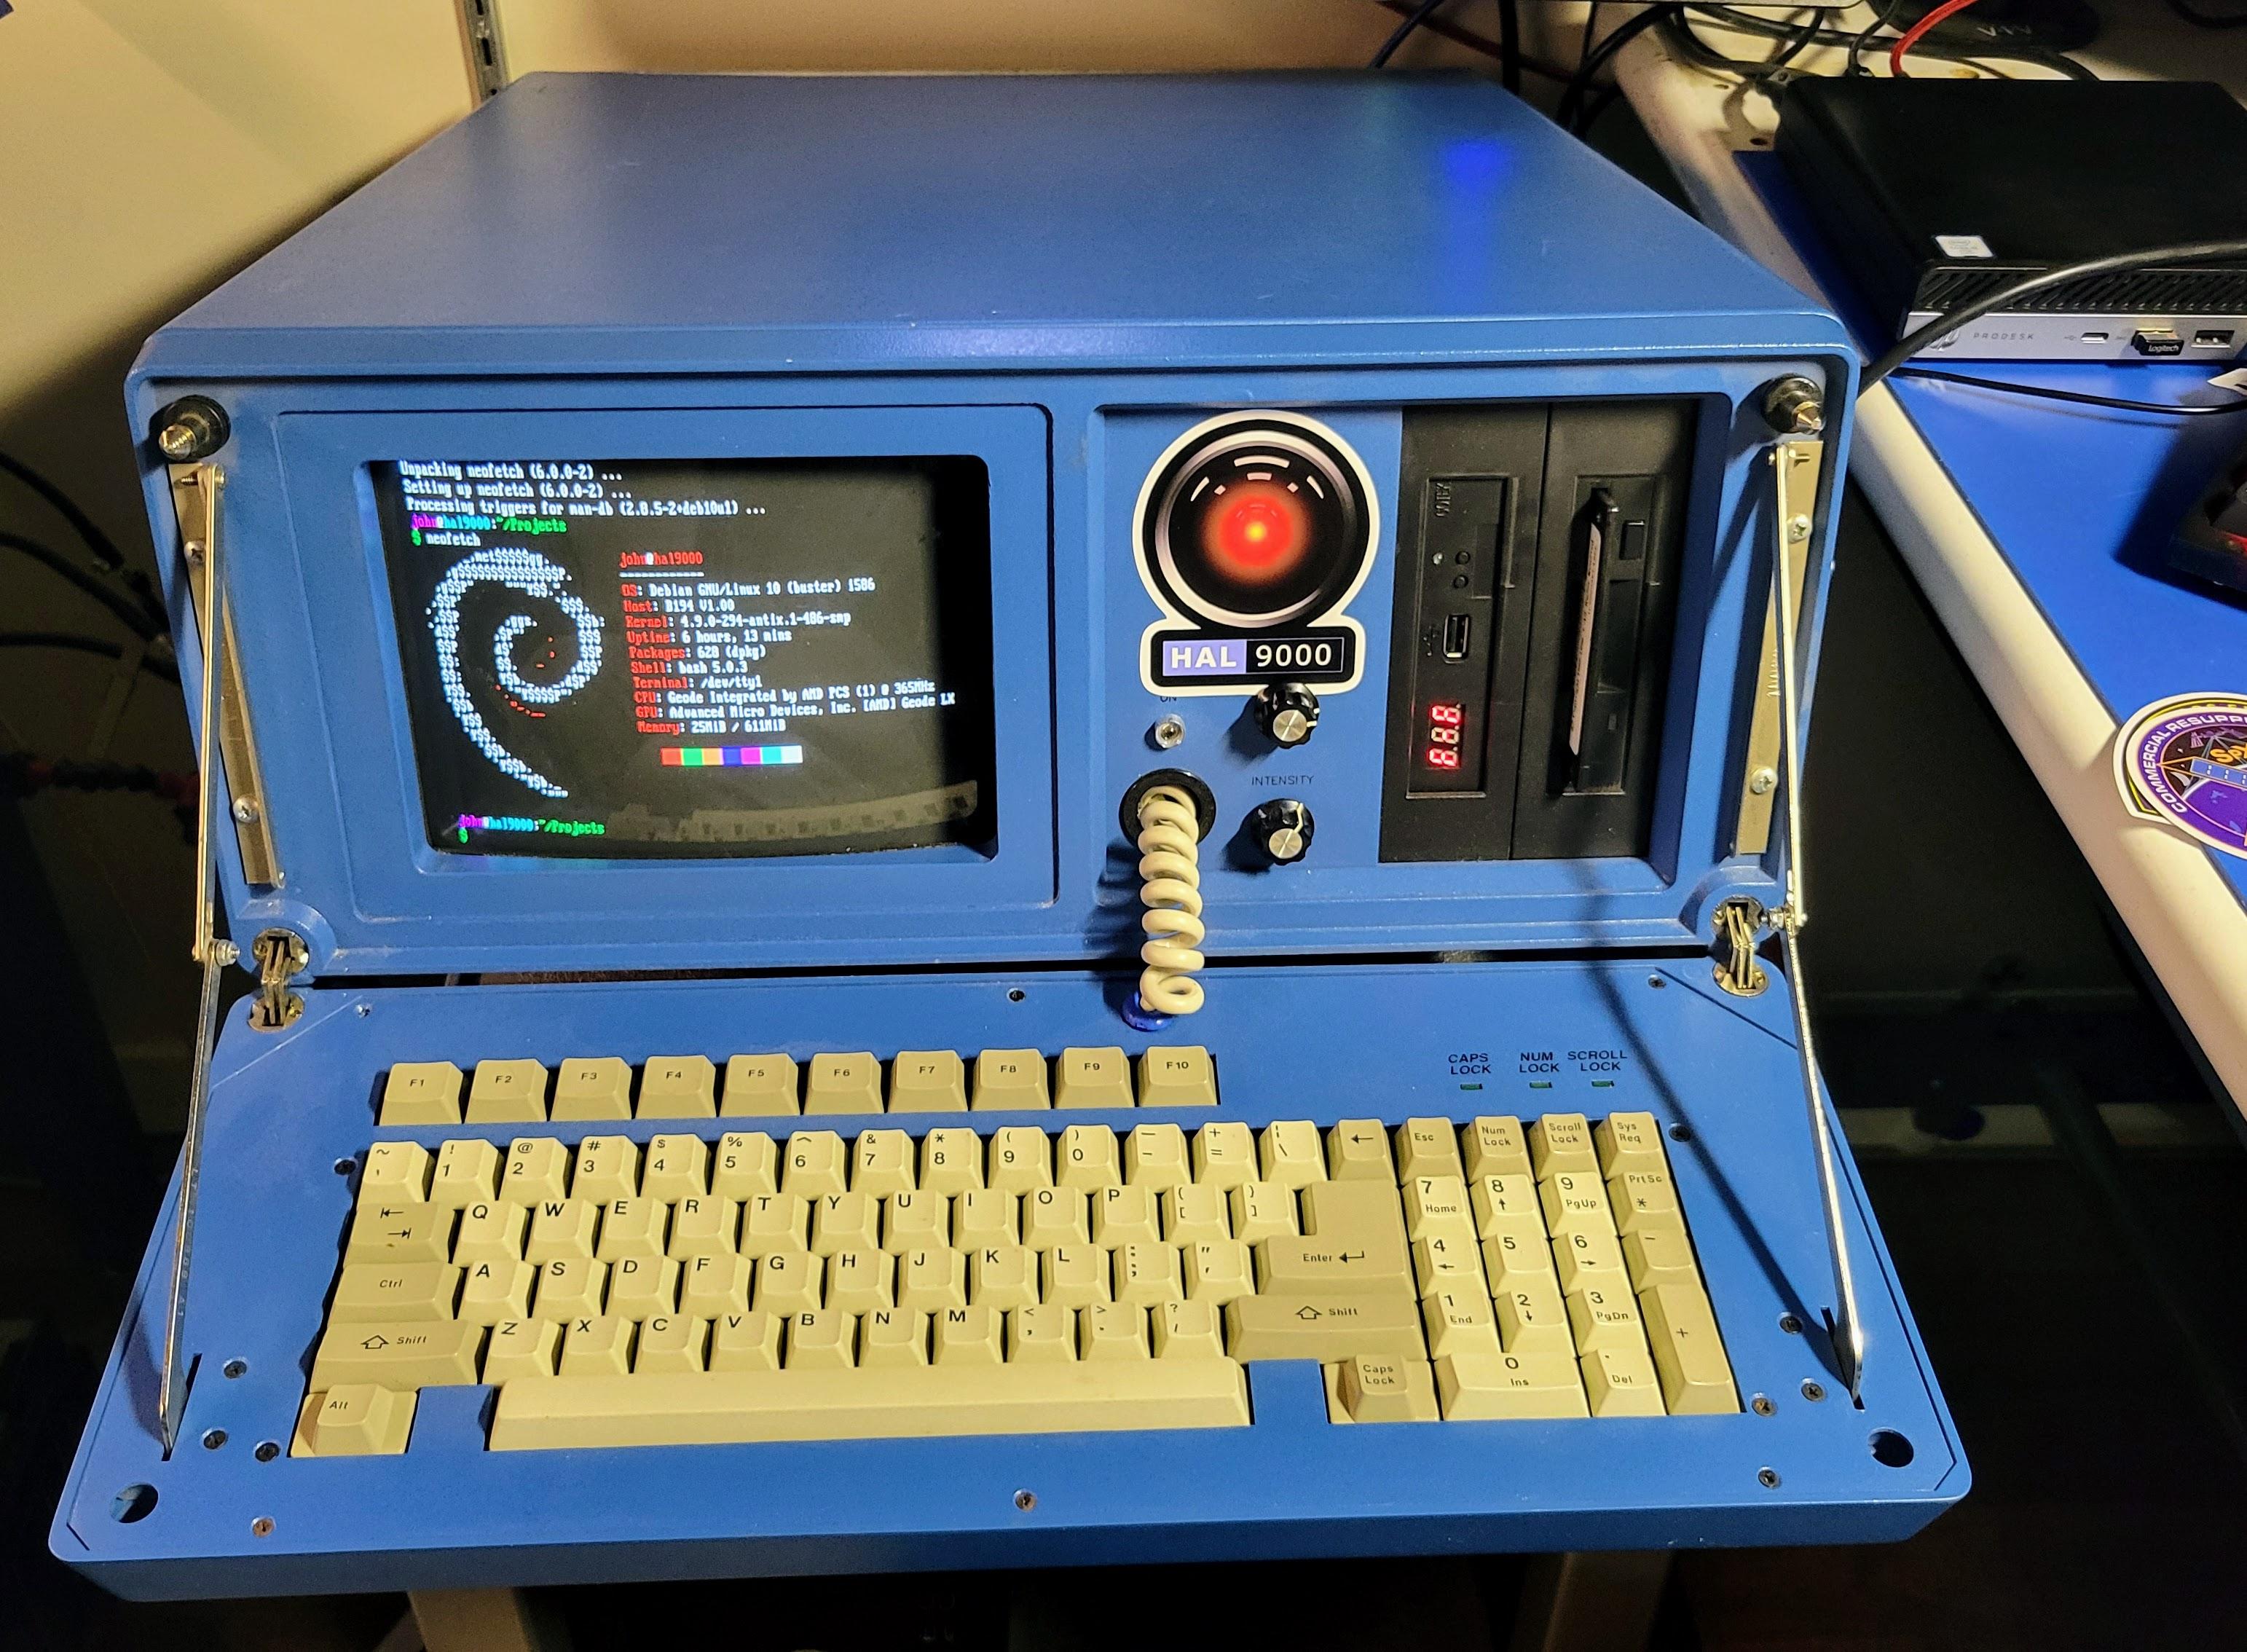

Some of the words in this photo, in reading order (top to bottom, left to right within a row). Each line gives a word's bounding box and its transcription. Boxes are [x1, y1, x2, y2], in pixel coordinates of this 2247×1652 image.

[1973, 332, 2035, 340] PRODESK
[398, 460, 463, 481] Unpacking
[466, 463, 524, 479] neofetch
[402, 478, 452, 498] Setting
[455, 484, 472, 499] up
[476, 481, 534, 497] neofetch
[405, 495, 475, 516] Processing
[479, 499, 537, 517] triggers
[540, 500, 564, 516] for
[425, 532, 481, 546] neofetch
[648, 583, 693, 597] Debian
[697, 581, 760, 597] GNU/Linux
[766, 581, 781, 595] 10
[787, 578, 842, 594] (buster)
[623, 599, 659, 613] Host:
[625, 615, 674, 629] Kernel:
[626, 630, 676, 645] Uptime:
[681, 630, 690, 644] 6
[695, 629, 737, 644] hours,
[744, 629, 759, 643] 13
[763, 629, 792, 642] mins
[629, 645, 691, 661] Packages:
[725, 644, 766, 661] (dpkg)
[1170, 646, 1237, 669] HAL
[1255, 644, 1332, 668] 9000
[631, 661, 672, 674] Shell:
[677, 661, 708, 674] bash
[712, 661, 748, 674] 5.0.3
[632, 676, 695, 689] Terminal:
[634, 691, 662, 704] CPU:
[666, 691, 704, 704] Geode
[709, 689, 778, 705] Integrated
[782, 689, 798, 704] by
[801, 687, 824, 701] AMD
[828, 685, 850, 699] PCS
[635, 706, 664, 718] GPU:
[668, 705, 725, 719] Advanced
[729, 704, 766, 718] Micro
[769, 704, 824, 717] Devices,
[830, 701, 857, 715] Inc.
[901, 695, 936, 709] Geode
[940, 692, 956, 706] LX
[637, 720, 685, 735] Memory:
[2143, 731, 2188, 814] COMMERCIAL
[1252, 775, 1315, 786] INTENSITY
[1448, 1053, 1489, 1063] CAPS
[1520, 1052, 1554, 1061] NUM
[1567, 1050, 1627, 1061] SCROLL
[919, 1066, 935, 1074] F7
[1001, 1065, 1017, 1073] F8
[1085, 1063, 1101, 1071] F9
[1166, 1061, 1189, 1069] F10
[1450, 1063, 1492, 1074] LOCK
[1519, 1062, 1559, 1073] LOCK
[1581, 1061, 1622, 1071] LOCK
[495, 1075, 513, 1084] F2
[581, 1072, 597, 1080] F3
[666, 1071, 682, 1079] F4
[748, 1069, 765, 1077] F5
[834, 1069, 850, 1077] F6
[410, 1079, 425, 1087] F1
[1481, 1125, 1506, 1135] Num
[1548, 1122, 1581, 1133] Scroll
[1617, 1122, 1637, 1133] Sys
[1414, 1132, 1434, 1141] Esc
[1484, 1136, 1511, 1146] Lock
[1551, 1133, 1579, 1144] Lock
[1619, 1133, 1642, 1144] Req
[865, 1153, 876, 1165] 7
[934, 1152, 945, 1165] 8
[1004, 1150, 1015, 1163] 9
[1073, 1148, 1084, 1160] 0
[583, 1160, 595, 1173] 3
[654, 1158, 665, 1171] 4
[725, 1156, 736, 1168] 5
[795, 1155, 806, 1167] 6
[443, 1164, 451, 1177] 1
[512, 1163, 524, 1175] 2
[1421, 1180, 1432, 1194] 7
[1492, 1179, 1504, 1192] 8
[1561, 1176, 1574, 1190] 9
[898, 1194, 911, 1208] U
[967, 1193, 972, 1207] I
[1038, 1190, 1053, 1205] O
[1109, 1189, 1120, 1202] P
[614, 1201, 629, 1215] E
[685, 1199, 699, 1213] R
[757, 1197, 771, 1211] T
[827, 1195, 841, 1210] Y
[1425, 1203, 1457, 1214] Home
[1566, 1198, 1597, 1210] PgUp
[472, 1205, 489, 1219] Q
[545, 1203, 565, 1217] W
[1433, 1239, 1446, 1253] 4
[1503, 1237, 1516, 1250] 5
[1575, 1235, 1588, 1248] 6
[841, 1254, 856, 1267] H
[914, 1253, 925, 1266] J
[985, 1250, 999, 1264] K
[1058, 1248, 1070, 1262] L
[1303, 1252, 1332, 1262] Enter
[551, 1262, 565, 1276] S
[623, 1260, 638, 1273] D
[696, 1258, 710, 1271] F
[769, 1256, 784, 1270] G
[476, 1264, 490, 1278] A
[379, 1280, 402, 1288] Ctrl
[1444, 1294, 1455, 1307] 1
[1517, 1294, 1531, 1307] 2
[1590, 1291, 1603, 1304] 3
[875, 1312, 890, 1324] N
[949, 1310, 966, 1323] M
[1329, 1307, 1358, 1316] Shift
[1597, 1312, 1629, 1322] PgDn
[577, 1320, 591, 1332] X
[653, 1318, 669, 1332] C
[728, 1315, 741, 1328] V
[801, 1313, 815, 1326] B
[1450, 1315, 1473, 1324] End
[502, 1322, 518, 1334] Z
[397, 1335, 427, 1345] Shift
[1363, 1364, 1393, 1375] Caps
[1505, 1356, 1519, 1370] 0
[1365, 1375, 1395, 1385] Lock
[1511, 1377, 1529, 1387] Ins
[1612, 1374, 1633, 1384] Del
[329, 1401, 348, 1409] Alt
